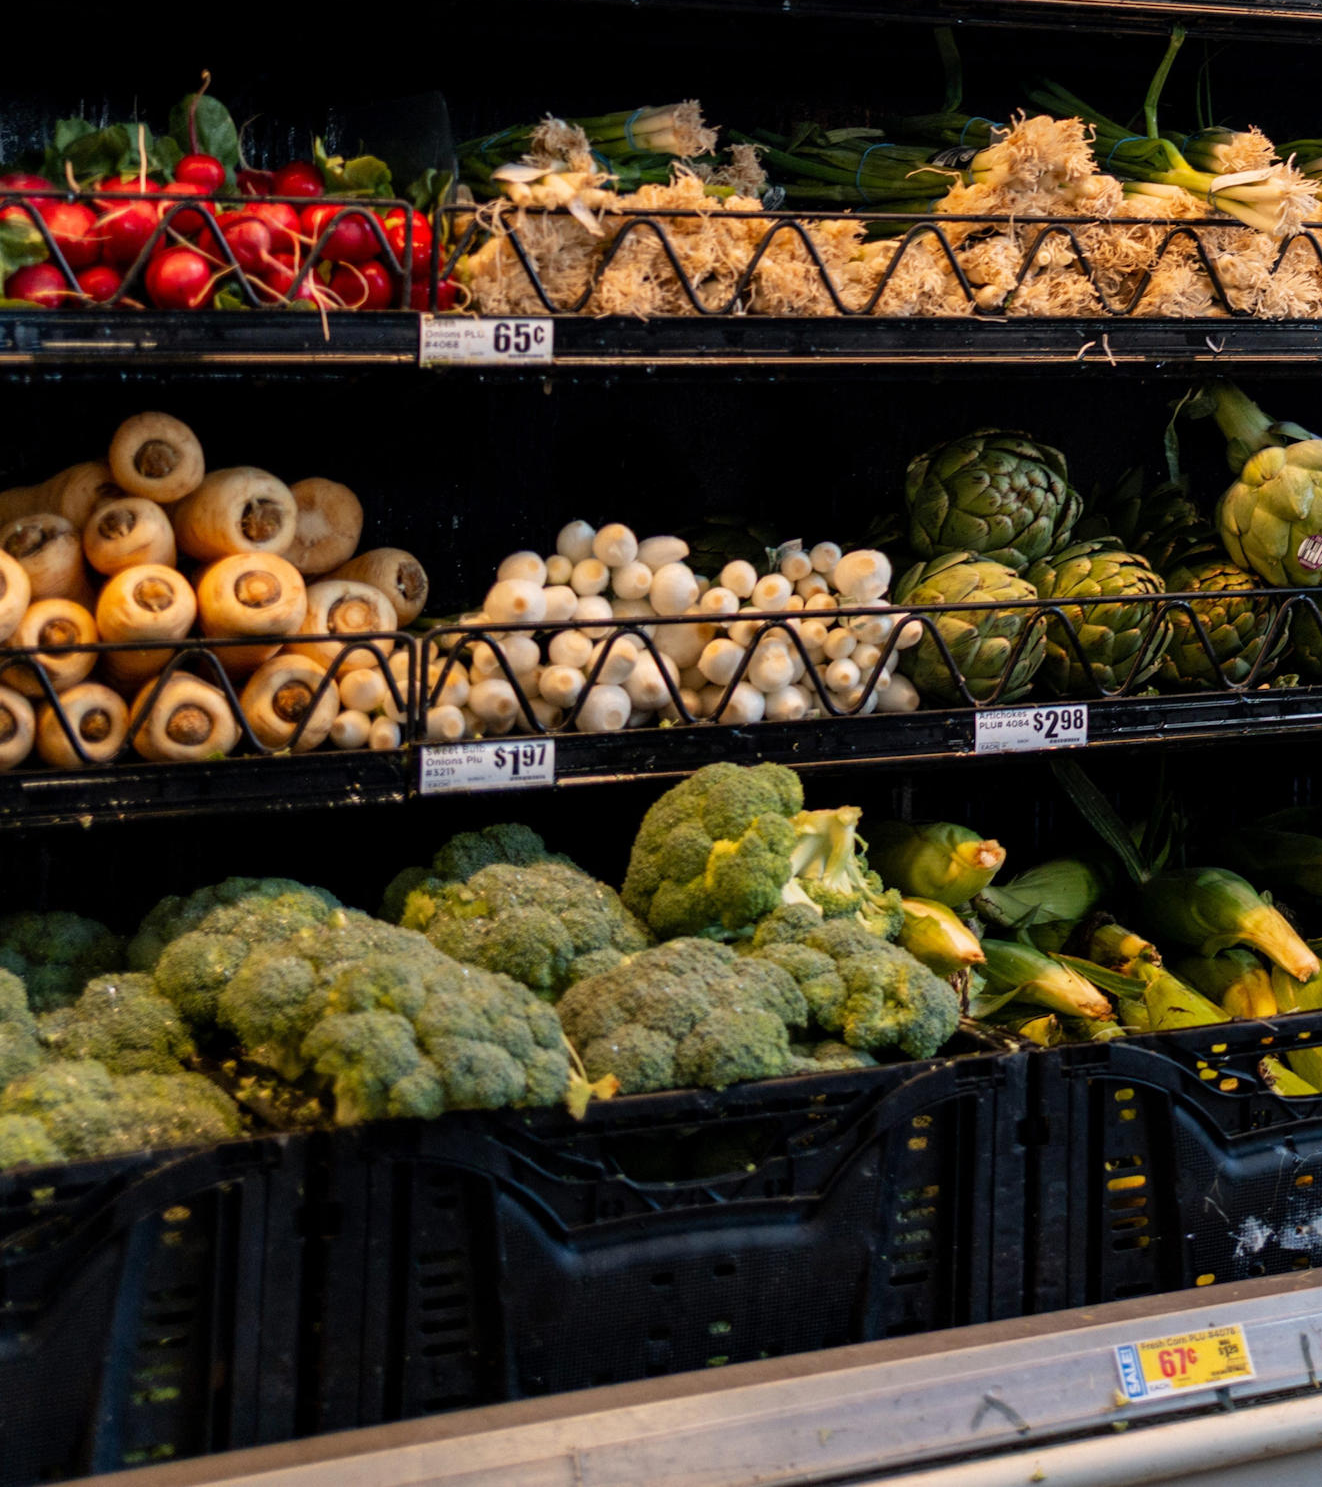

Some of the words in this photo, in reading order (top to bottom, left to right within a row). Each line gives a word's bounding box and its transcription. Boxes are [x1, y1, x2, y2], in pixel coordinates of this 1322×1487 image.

[425, 329, 461, 339] Onions
[493, 322, 546, 354] 65¢
[979, 710, 1027, 721] Artichokes
[979, 721, 1003, 730] PLU#
[1033, 709, 1085, 740] $298
[426, 755, 463, 767] Onions
[466, 755, 483, 764] Plu
[494, 743, 547, 776] $197
[1158, 1347, 1199, 1379] 67¢
